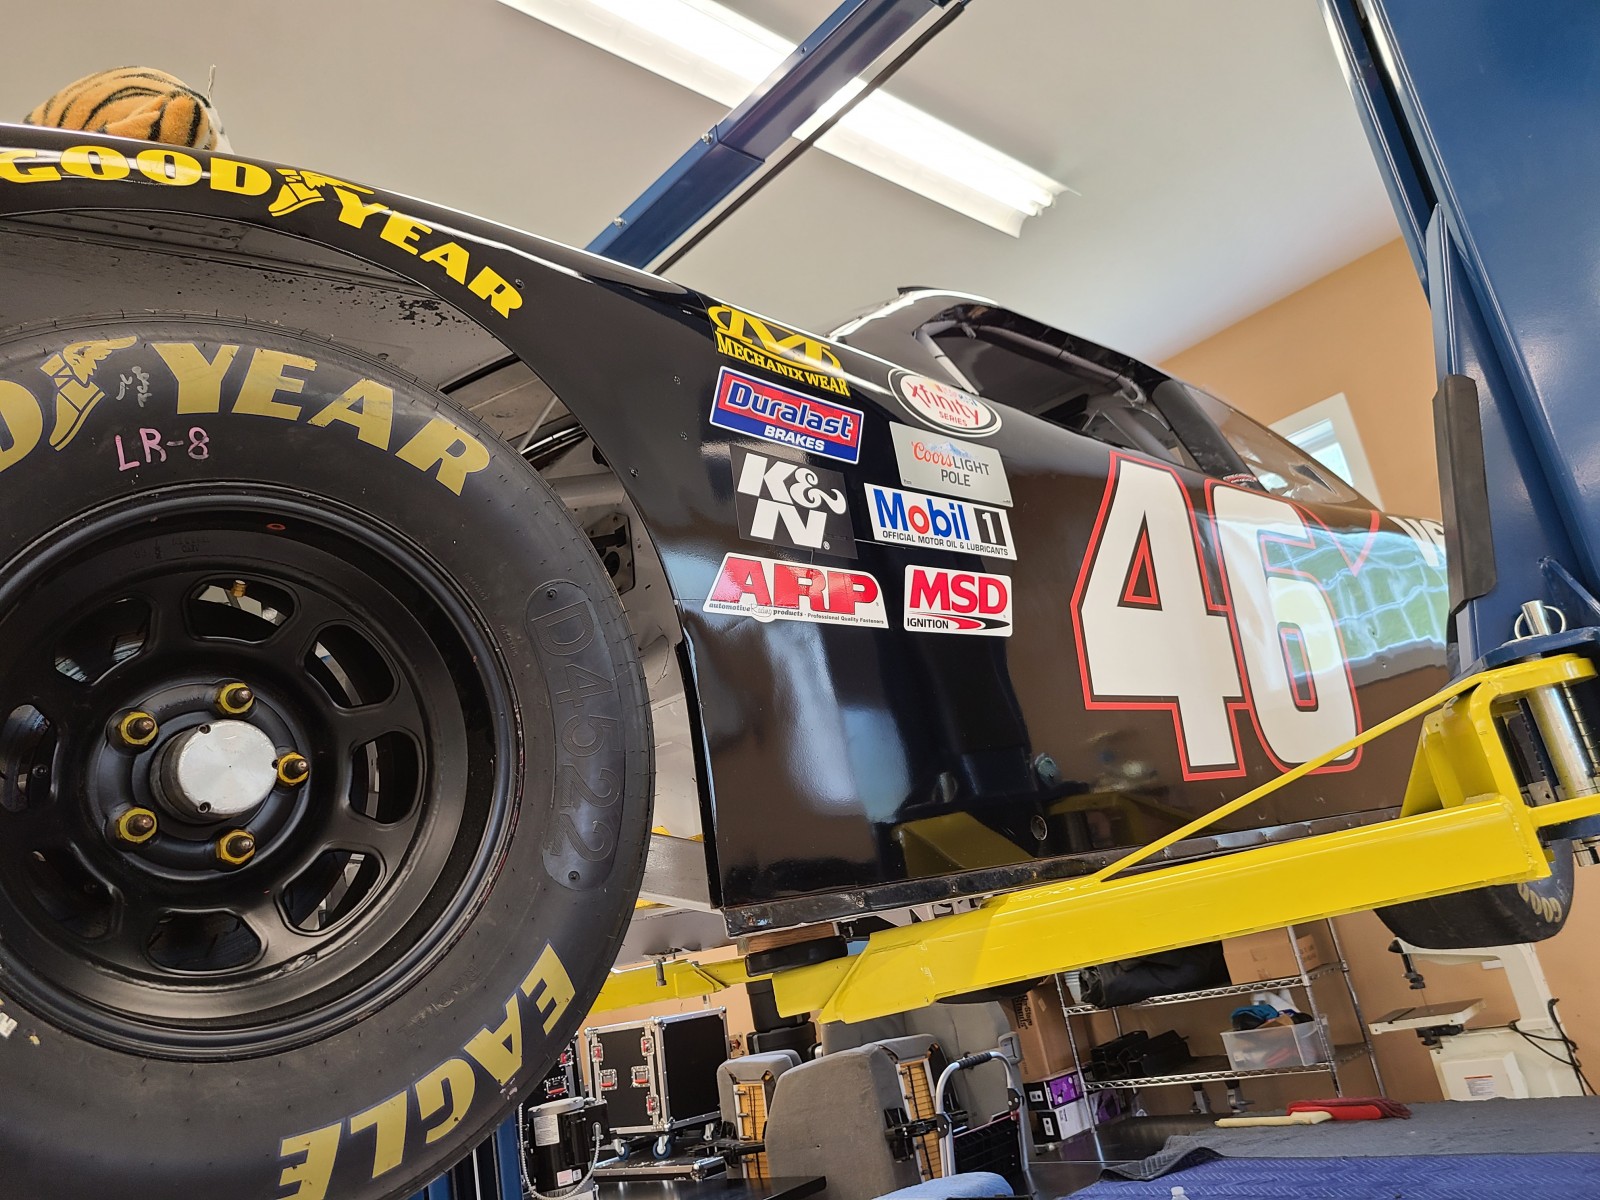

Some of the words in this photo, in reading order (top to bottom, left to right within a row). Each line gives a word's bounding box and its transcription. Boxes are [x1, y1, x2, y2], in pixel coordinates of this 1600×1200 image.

[714, 330, 806, 382] MECHANIX
[803, 371, 851, 398] WEAR
[725, 379, 854, 440] Duralast
[939, 410, 968, 427] SERIES
[115, 426, 210, 472] LR-8
[763, 424, 825, 452] BRAKES
[940, 468, 972, 488] POLE
[952, 456, 990, 476] LIGHT
[873, 488, 971, 542] Mobil
[882, 530, 916, 543] OFFICIAL
[917, 535, 945, 547] MOTOR
[946, 540, 958, 549] OIL
[959, 541, 965, 549] &
[966, 543, 1009, 556] LUBRICANTS
[711, 556, 879, 616] ARP
[909, 568, 1008, 616] MSD
[708, 602, 750, 612] automotive
[773, 609, 804, 618] products
[807, 612, 840, 621] Professional
[841, 615, 859, 624] Quality
[859, 617, 884, 625] Fasteners
[906, 616, 949, 630] IGNITION
[1070, 450, 1364, 782] 46
[278, 942, 576, 1200] EAGLE
